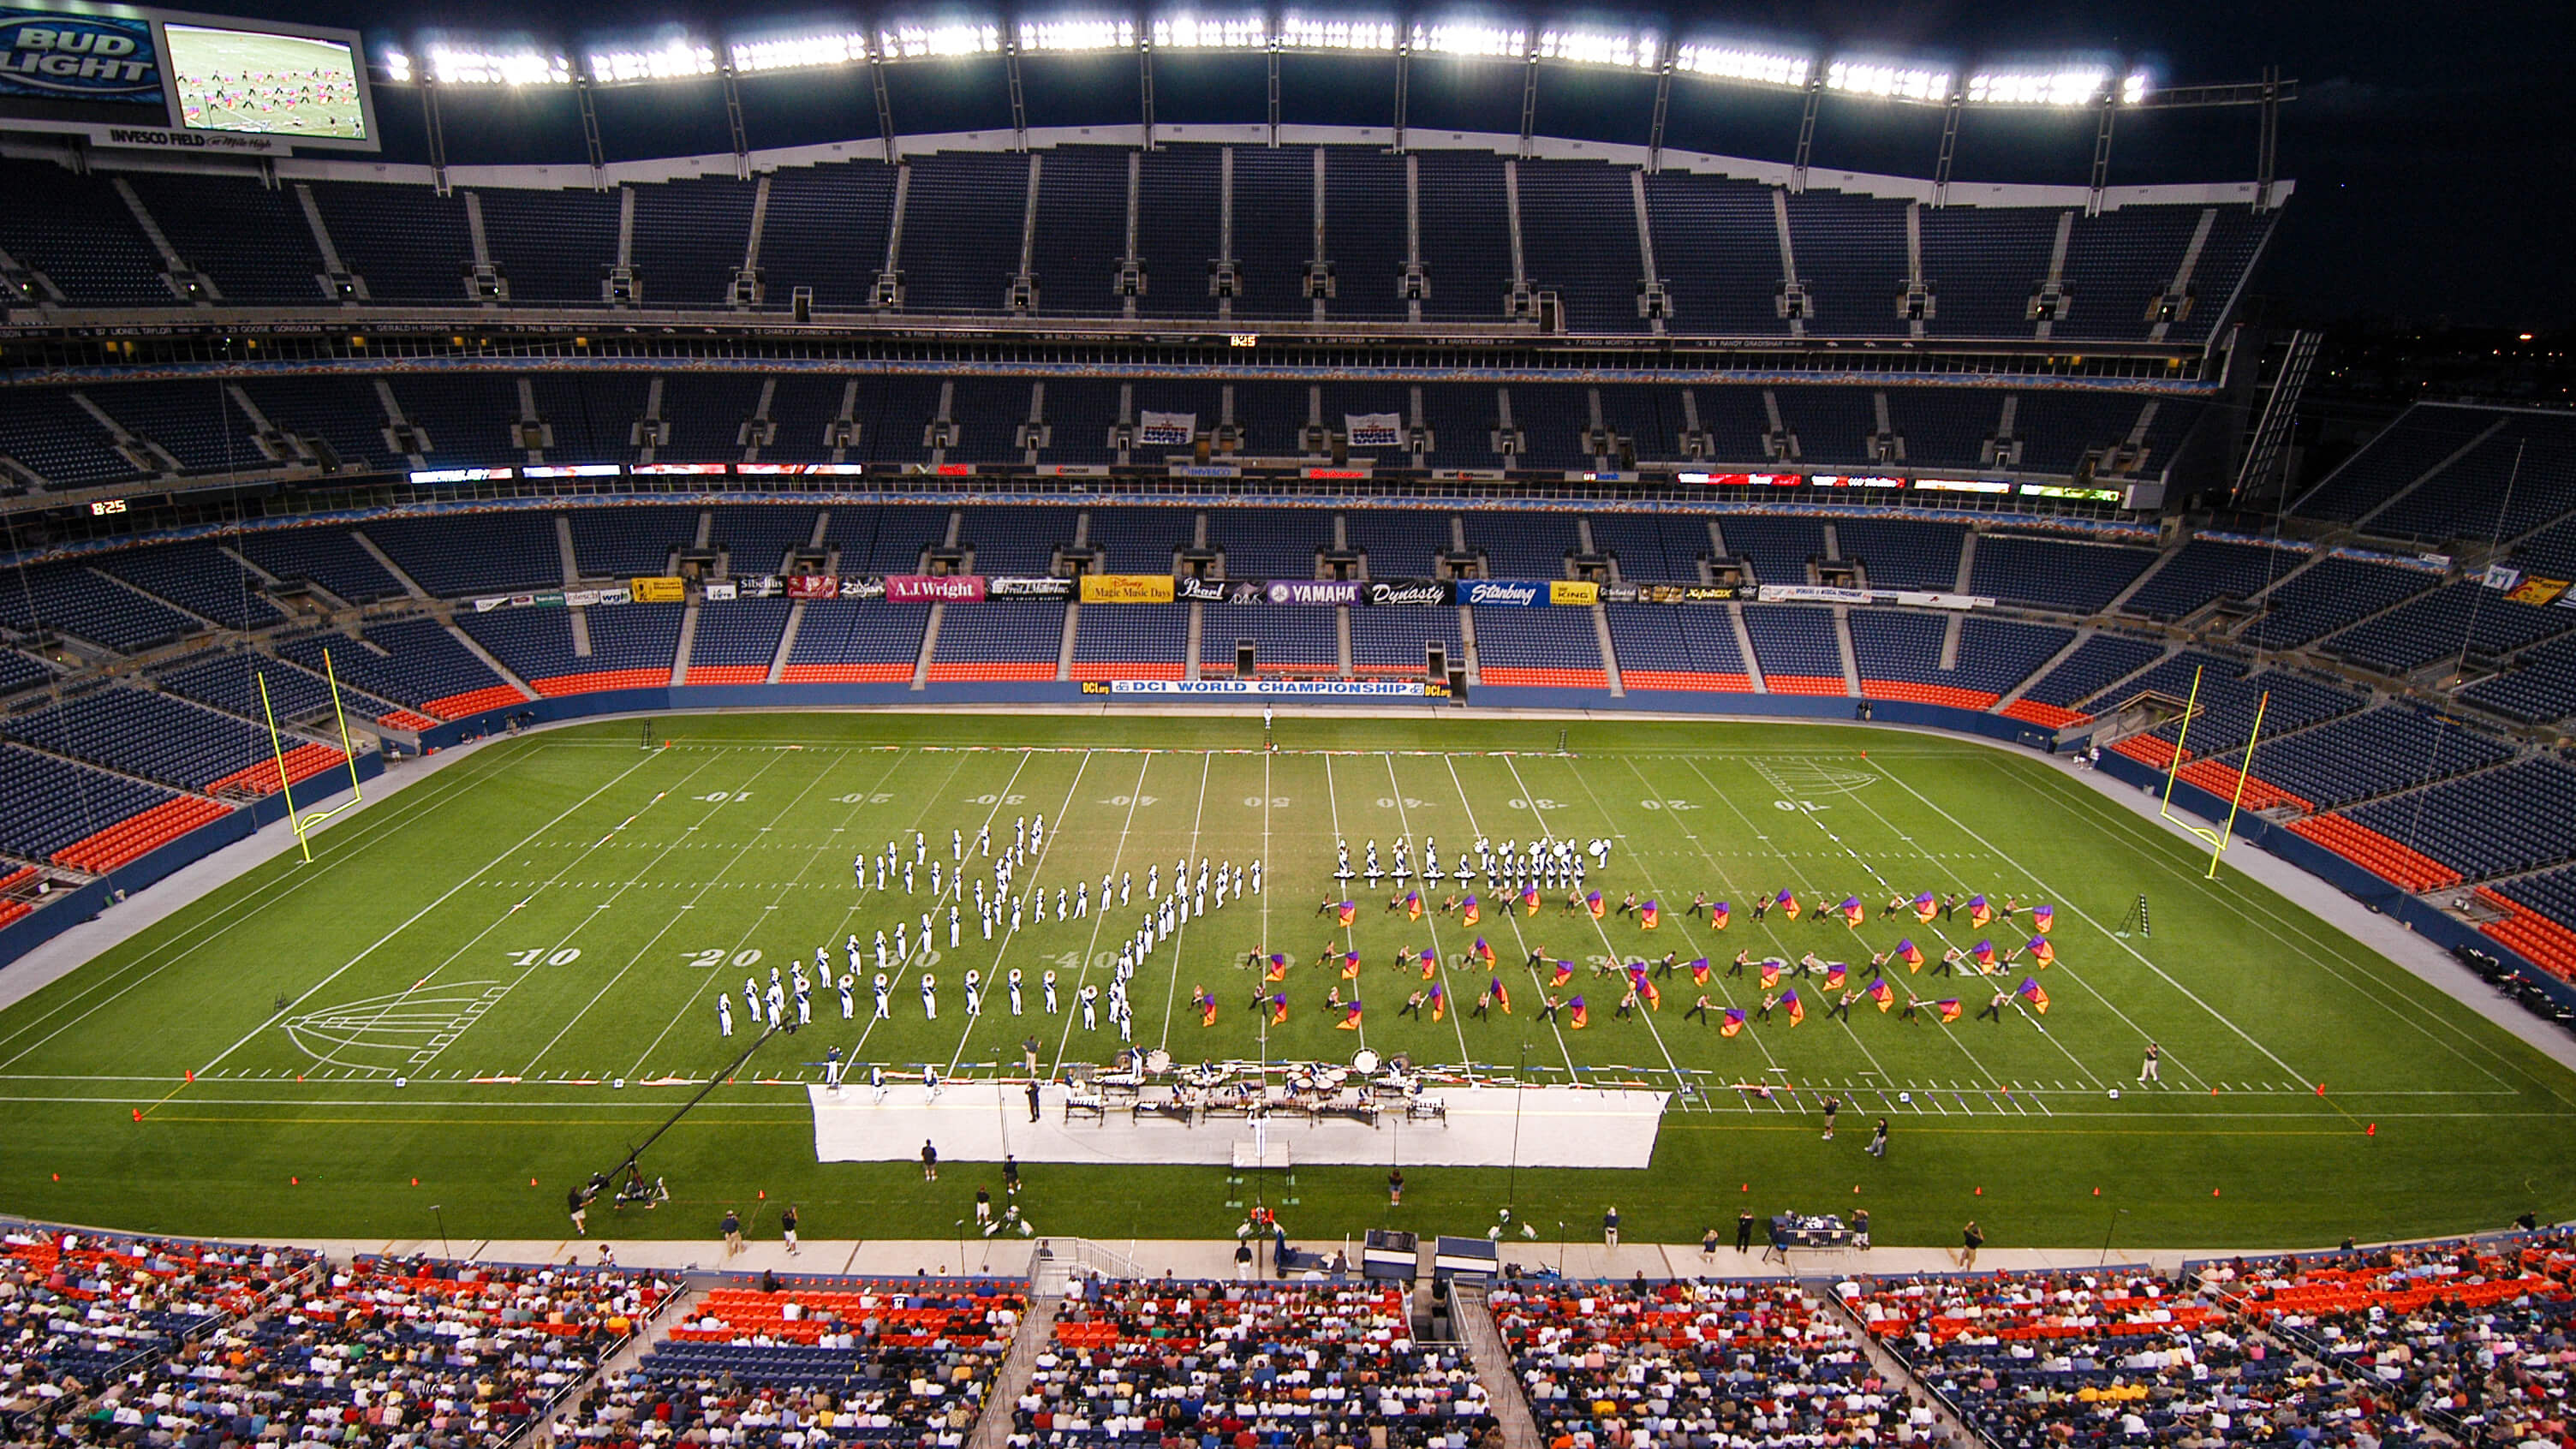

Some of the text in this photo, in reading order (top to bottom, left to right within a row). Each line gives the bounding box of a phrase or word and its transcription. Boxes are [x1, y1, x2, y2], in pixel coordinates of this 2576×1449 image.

[15, 27, 135, 57] BUD
[0, 51, 153, 81] LIGHT
[110, 129, 168, 145] INVESCO
[170, 132, 206, 146] FIELD
[741, 577, 784, 589] Sibelius
[922, 581, 974, 599] Wright
[1178, 576, 1225, 599] Pearl
[1094, 587, 1172, 599] Magic Music Days
[1292, 585, 1357, 602] YAMAHA
[1371, 583, 1445, 604] Dynasty
[1470, 583, 1536, 605] Stanbury
[1082, 682, 1109, 695] DCI.org
[1133, 682, 1166, 691] DCI
[1178, 682, 1247, 692] WORLD
[1258, 683, 1407, 693] CHAMPIONSHIP
[1425, 684, 1452, 697] DCI.org
[704, 791, 754, 802] 10
[841, 792, 895, 804] 20
[1508, 798, 1556, 809] 30
[1640, 799, 1690, 811] 20
[1774, 800, 1822, 812] 10
[514, 947, 581, 967] 10
[689, 948, 763, 968] 20
[1054, 951, 1119, 969] 40
